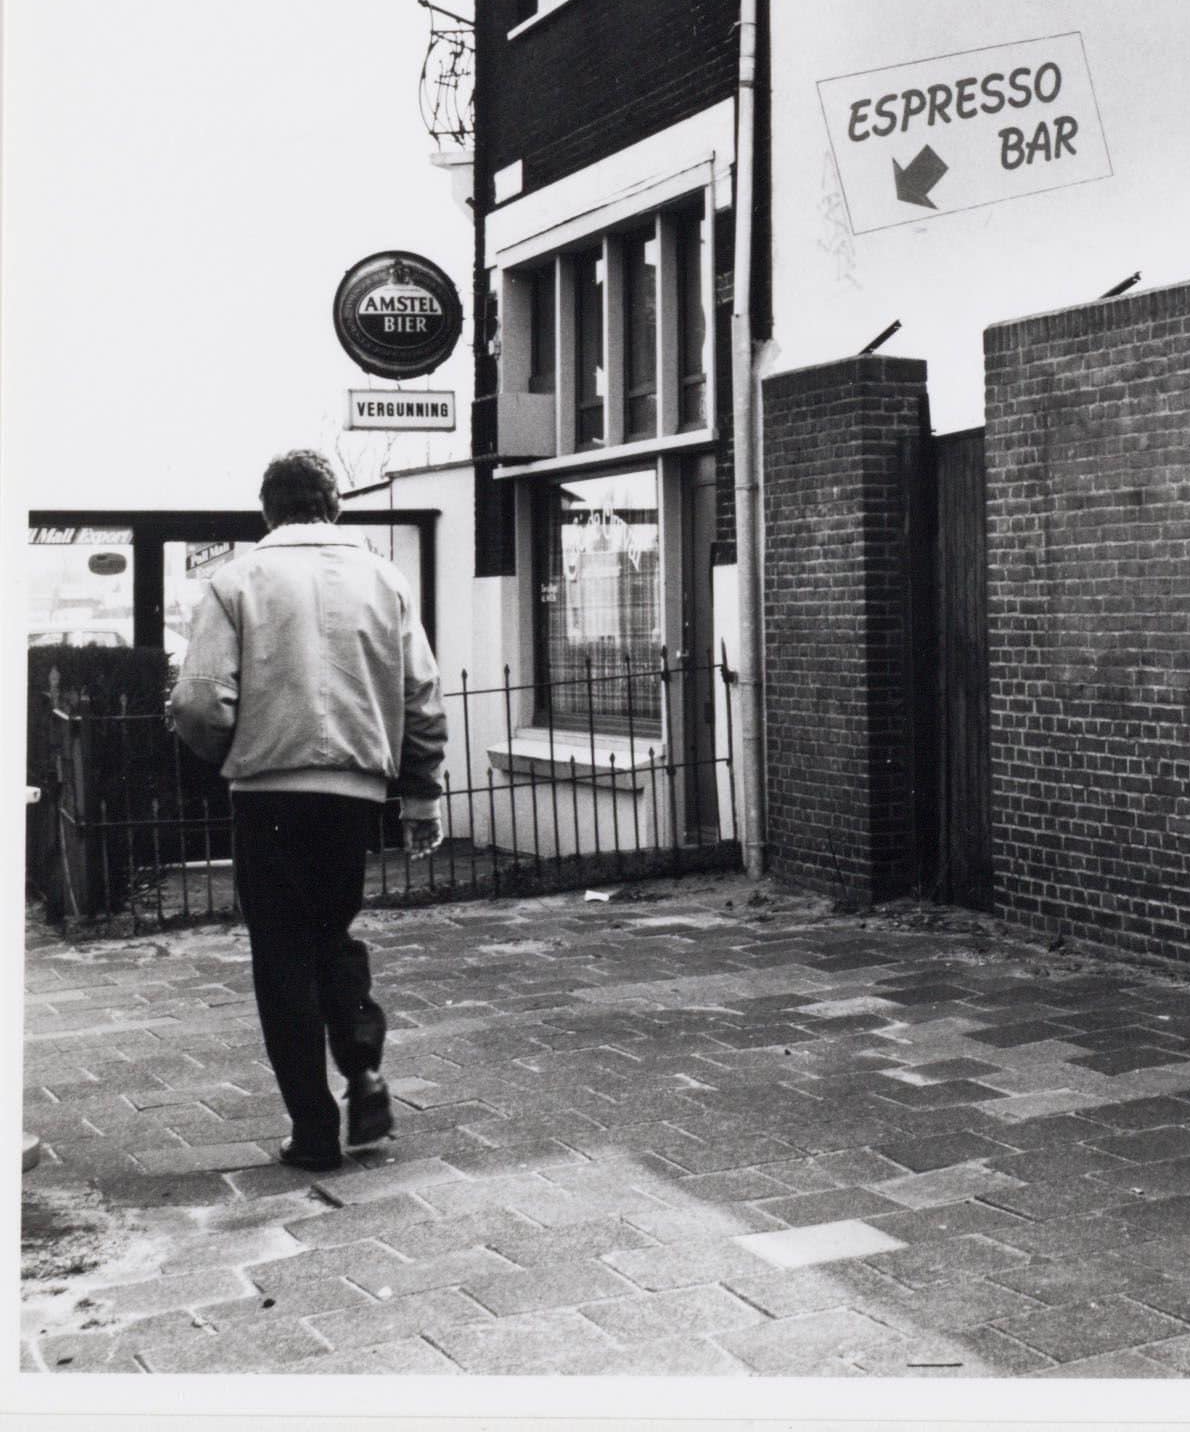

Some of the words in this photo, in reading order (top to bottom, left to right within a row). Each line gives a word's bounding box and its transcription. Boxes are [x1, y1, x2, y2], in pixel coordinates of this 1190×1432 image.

[848, 61, 1062, 142] ESPRESSO
[998, 115, 1078, 170] BAR
[365, 295, 438, 313] AMSTEL
[384, 316, 428, 333] BIER
[357, 401, 449, 418] VERGUNNING
[36, 528, 75, 544] Mall
